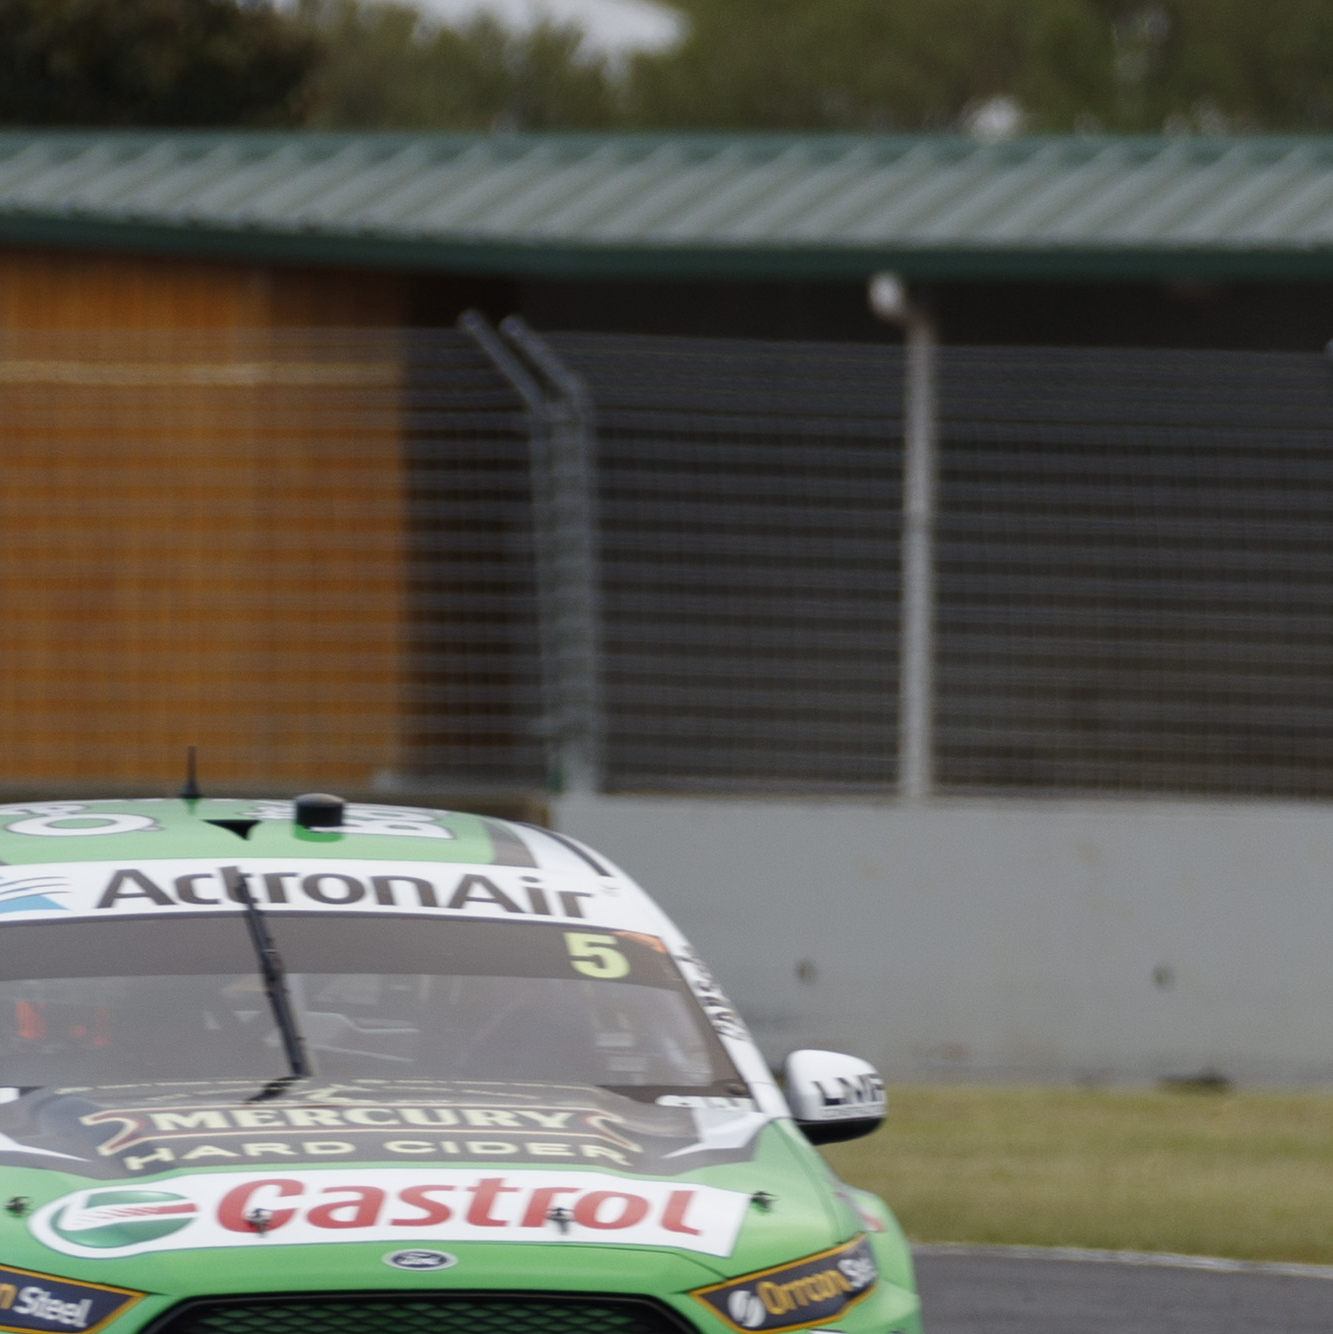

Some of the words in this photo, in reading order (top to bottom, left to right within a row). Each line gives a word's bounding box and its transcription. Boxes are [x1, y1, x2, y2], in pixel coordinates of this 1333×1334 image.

[96, 866, 592, 919] ActronAir
[564, 933, 631, 979] 5
[149, 1107, 578, 1131] MERCURY
[123, 1140, 357, 1171] HARD
[384, 1139, 634, 1167] CIDER
[215, 1177, 704, 1236] Castrol
